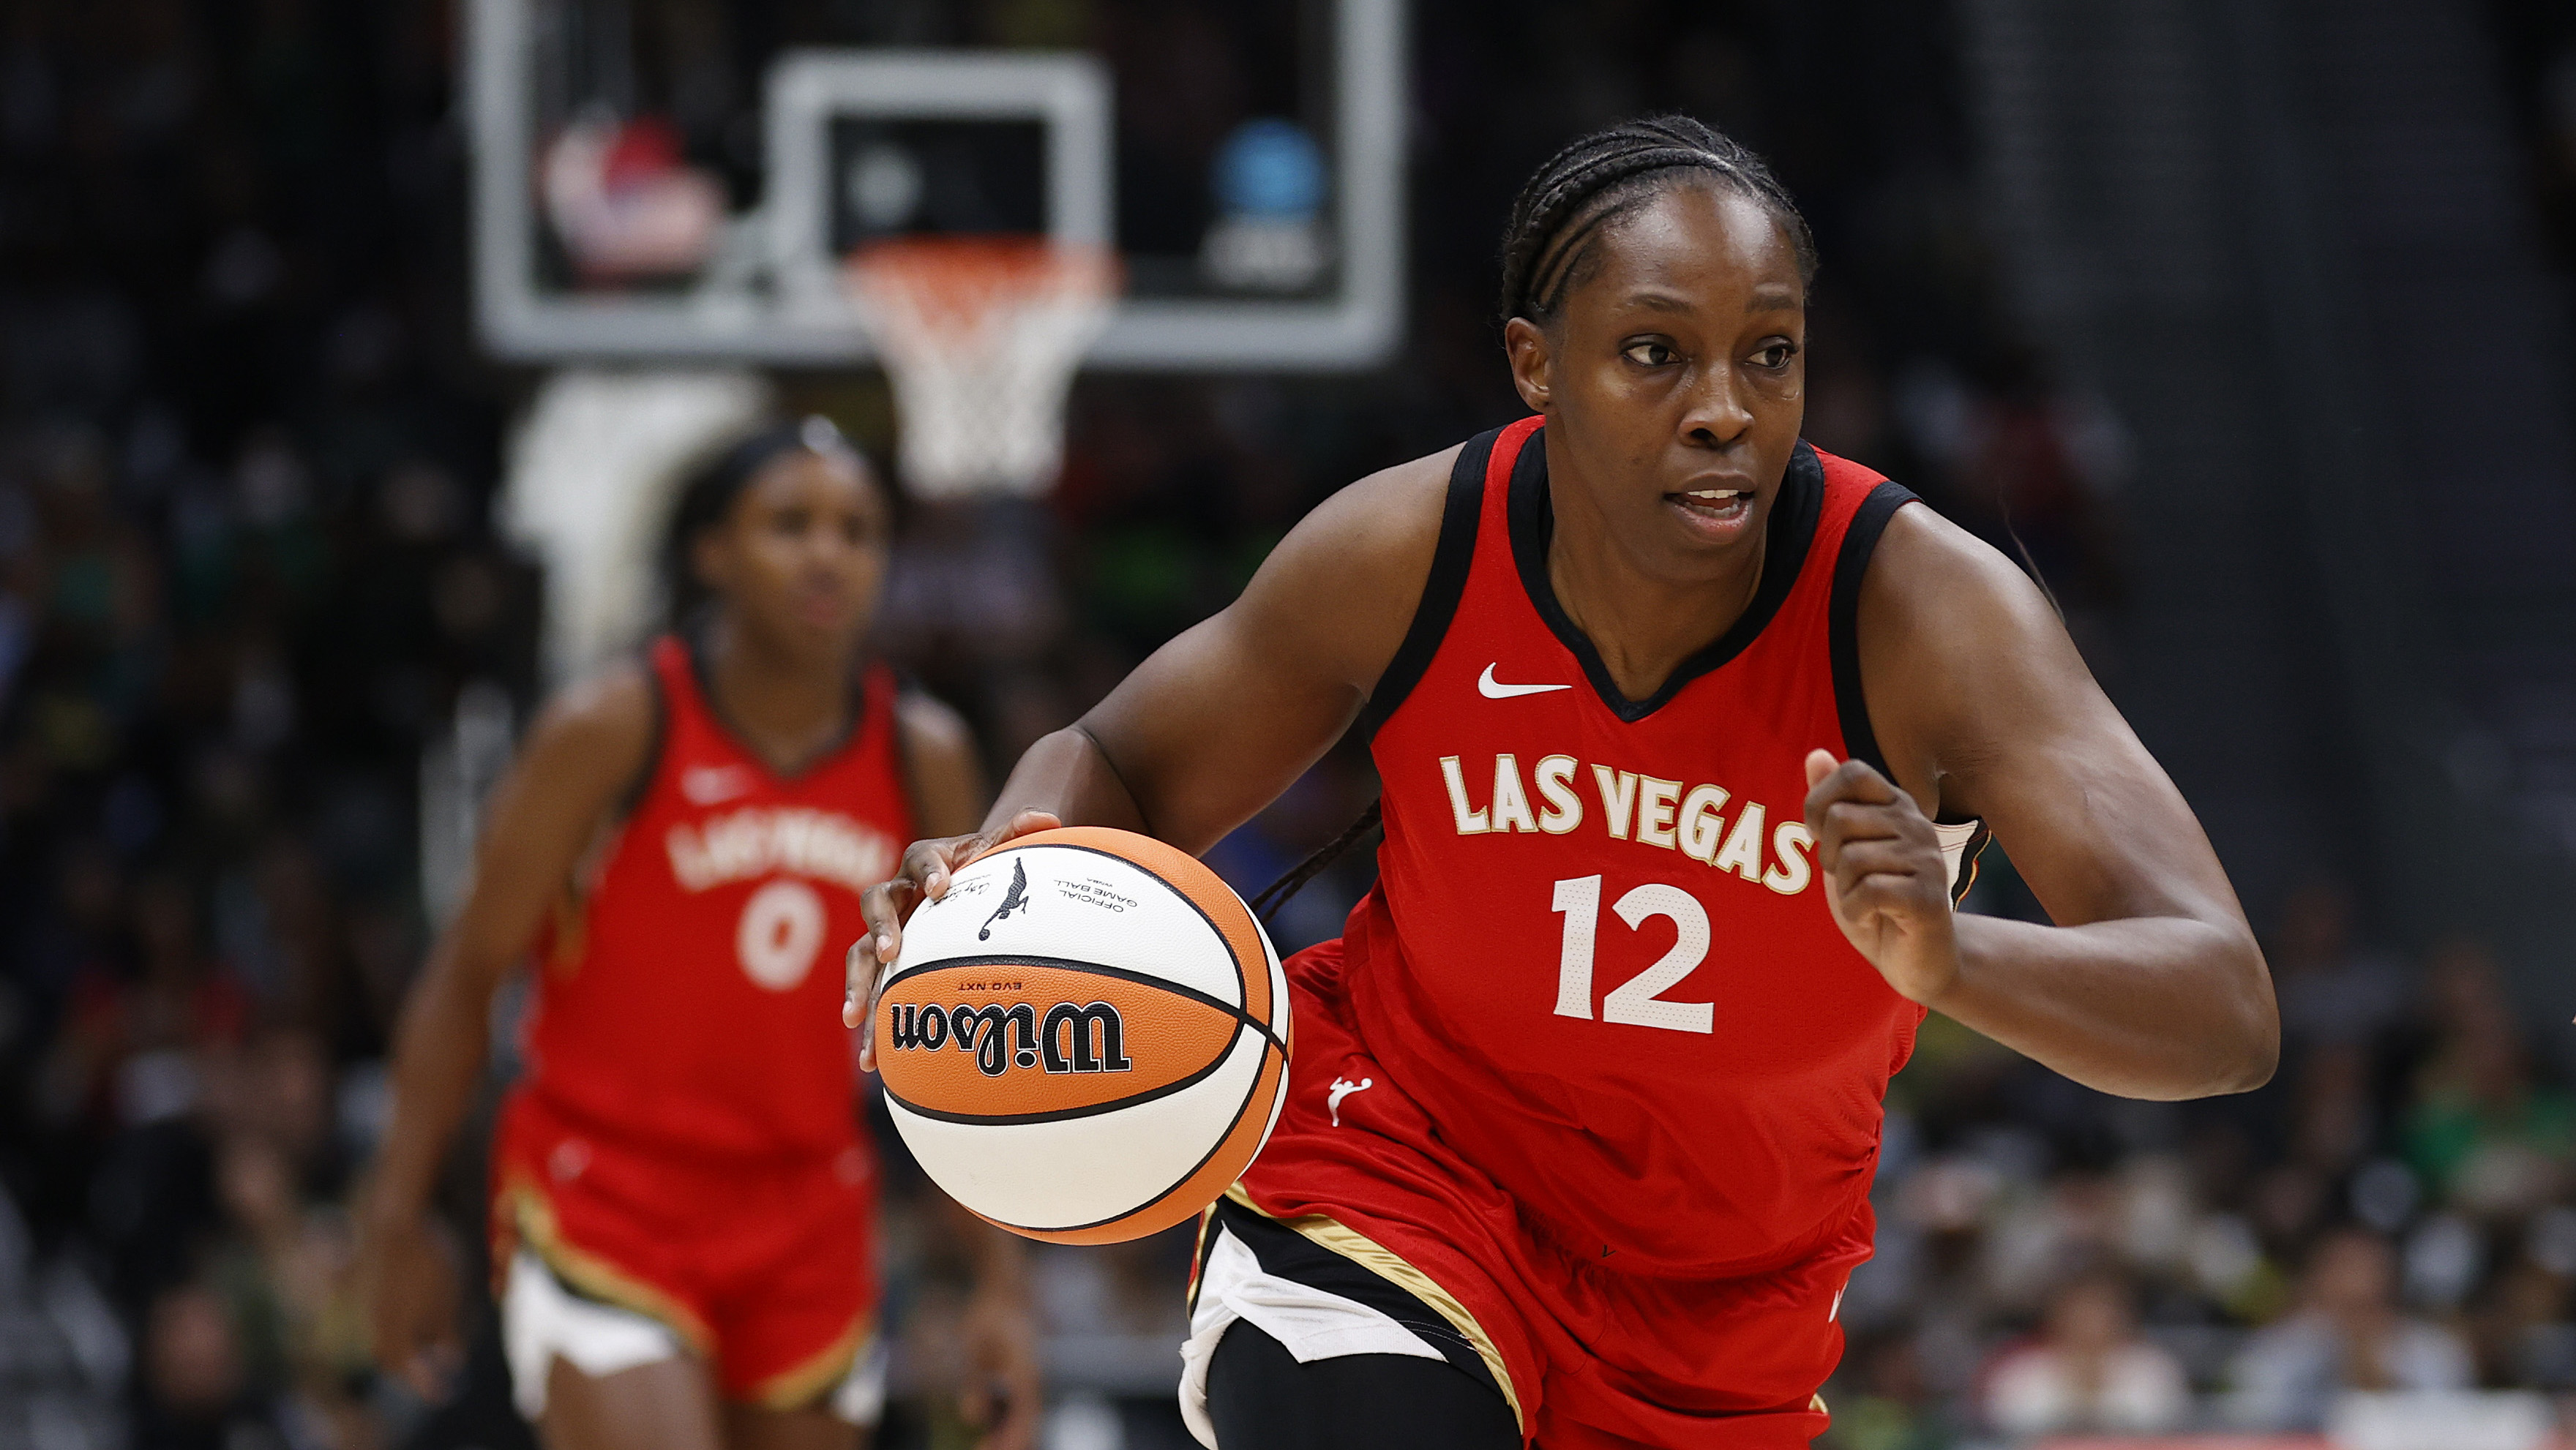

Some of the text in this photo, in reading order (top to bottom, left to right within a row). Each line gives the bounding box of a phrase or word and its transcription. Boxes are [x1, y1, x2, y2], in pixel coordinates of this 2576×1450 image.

[1439, 754, 1815, 895] LAS VEGAS
[1054, 879, 1137, 907] GAME BALL
[1060, 890, 1123, 912] OFFICIAL
[738, 881, 827, 991] 0
[1551, 874, 1715, 1034] 12
[958, 983, 1022, 991] EVO NXT
[891, 1002, 1131, 1077] Wilson
